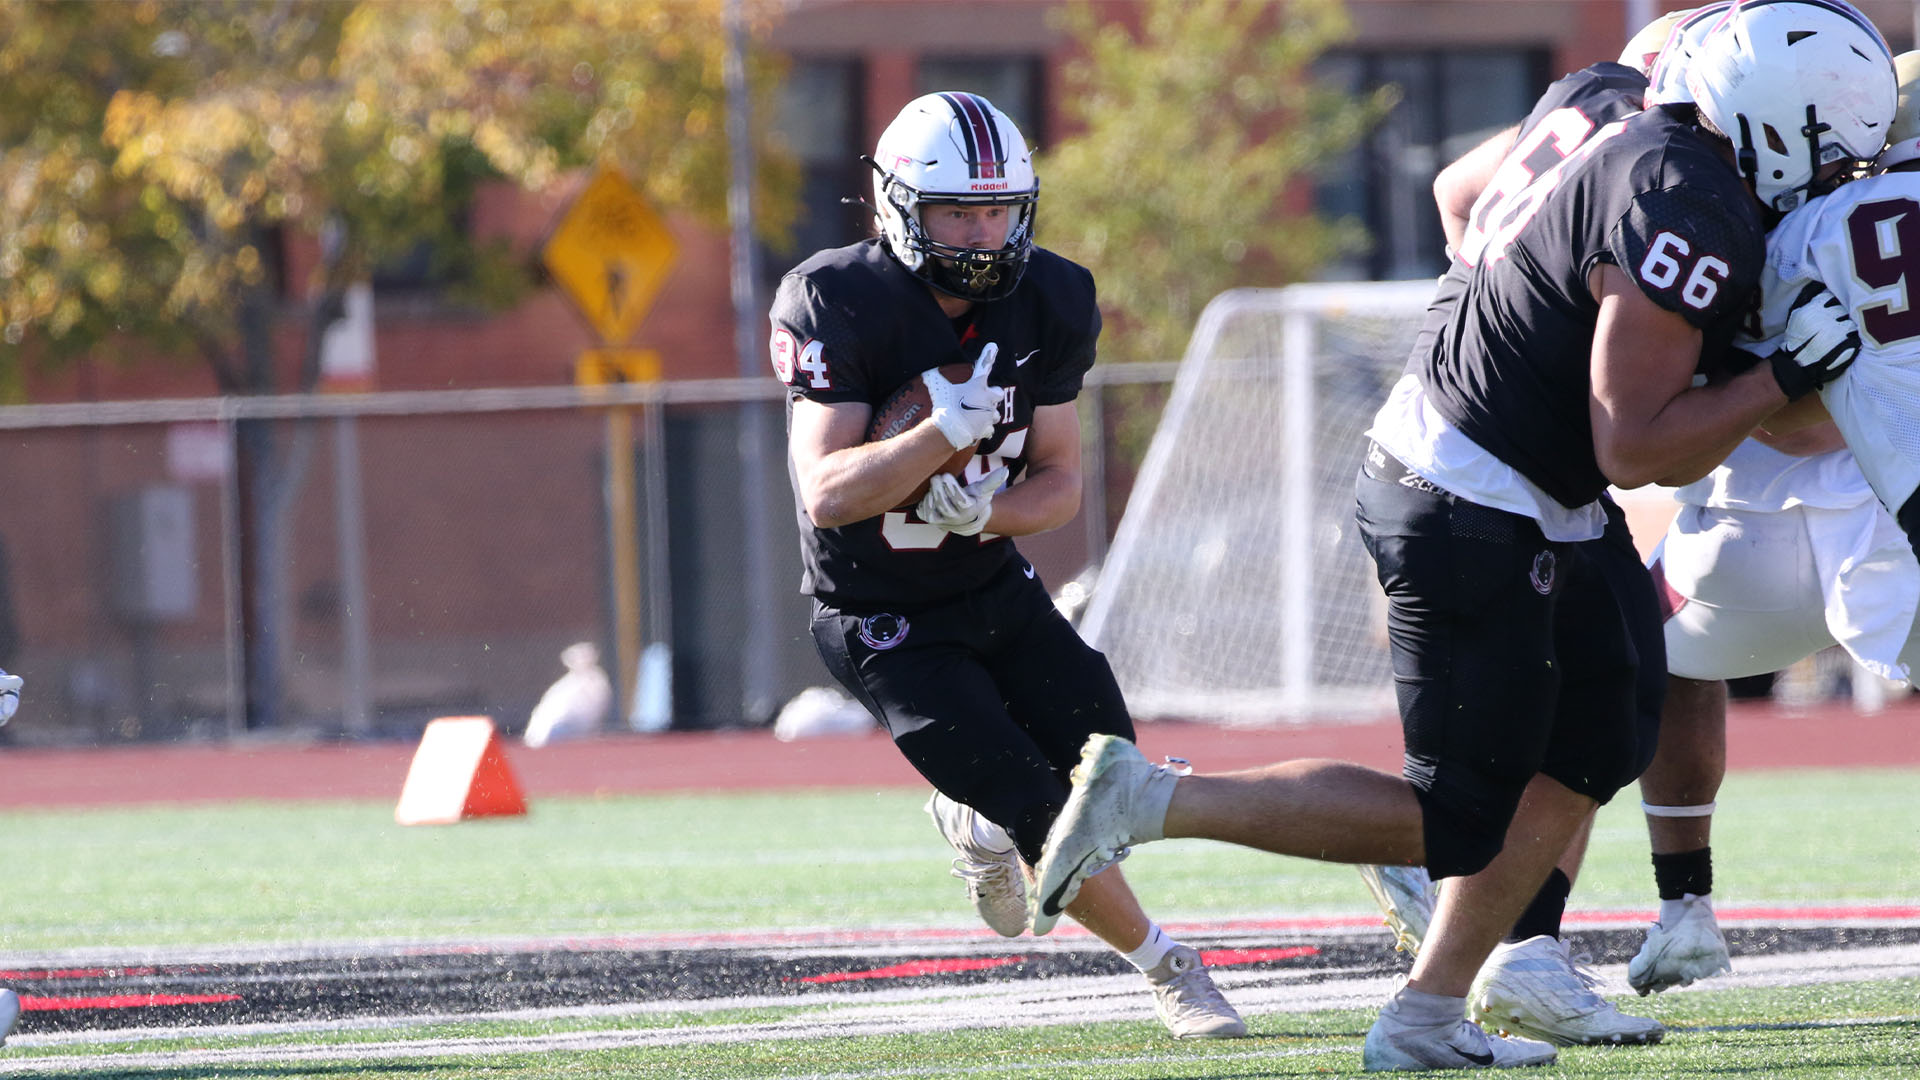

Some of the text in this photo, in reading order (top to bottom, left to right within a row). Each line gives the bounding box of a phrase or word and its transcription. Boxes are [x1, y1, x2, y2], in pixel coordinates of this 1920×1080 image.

[971, 182, 1008, 191] Riddell
[1638, 229, 1732, 311] 66
[774, 328, 831, 390] 34
